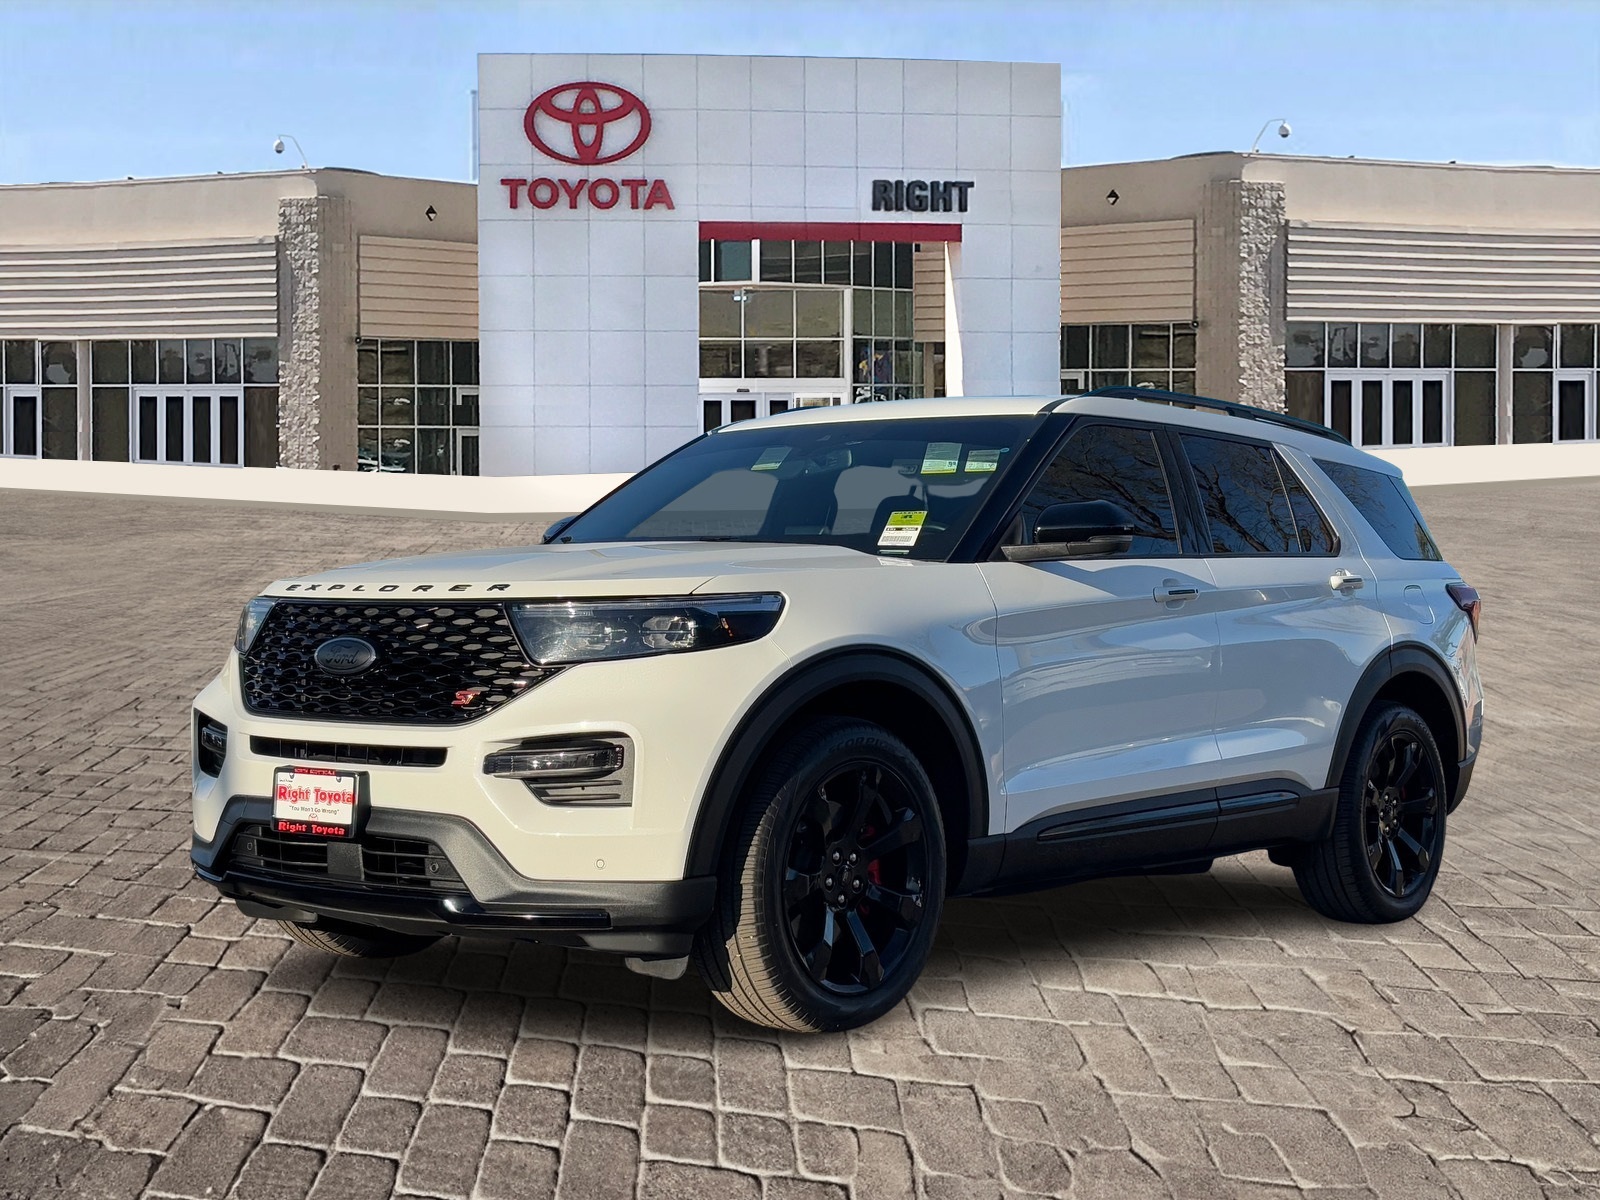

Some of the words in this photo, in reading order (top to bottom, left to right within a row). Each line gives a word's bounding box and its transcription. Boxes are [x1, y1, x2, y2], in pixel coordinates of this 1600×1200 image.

[500, 177, 675, 210] TOYOTA
[871, 179, 975, 212] RIGHT
[285, 583, 511, 592] EXPLORER
[326, 644, 360, 665] Ford
[451, 690, 481, 705] ST
[277, 785, 311, 803] Right
[314, 788, 355, 805] Toyota
[278, 821, 307, 833] Right
[311, 824, 345, 835] Toyota
